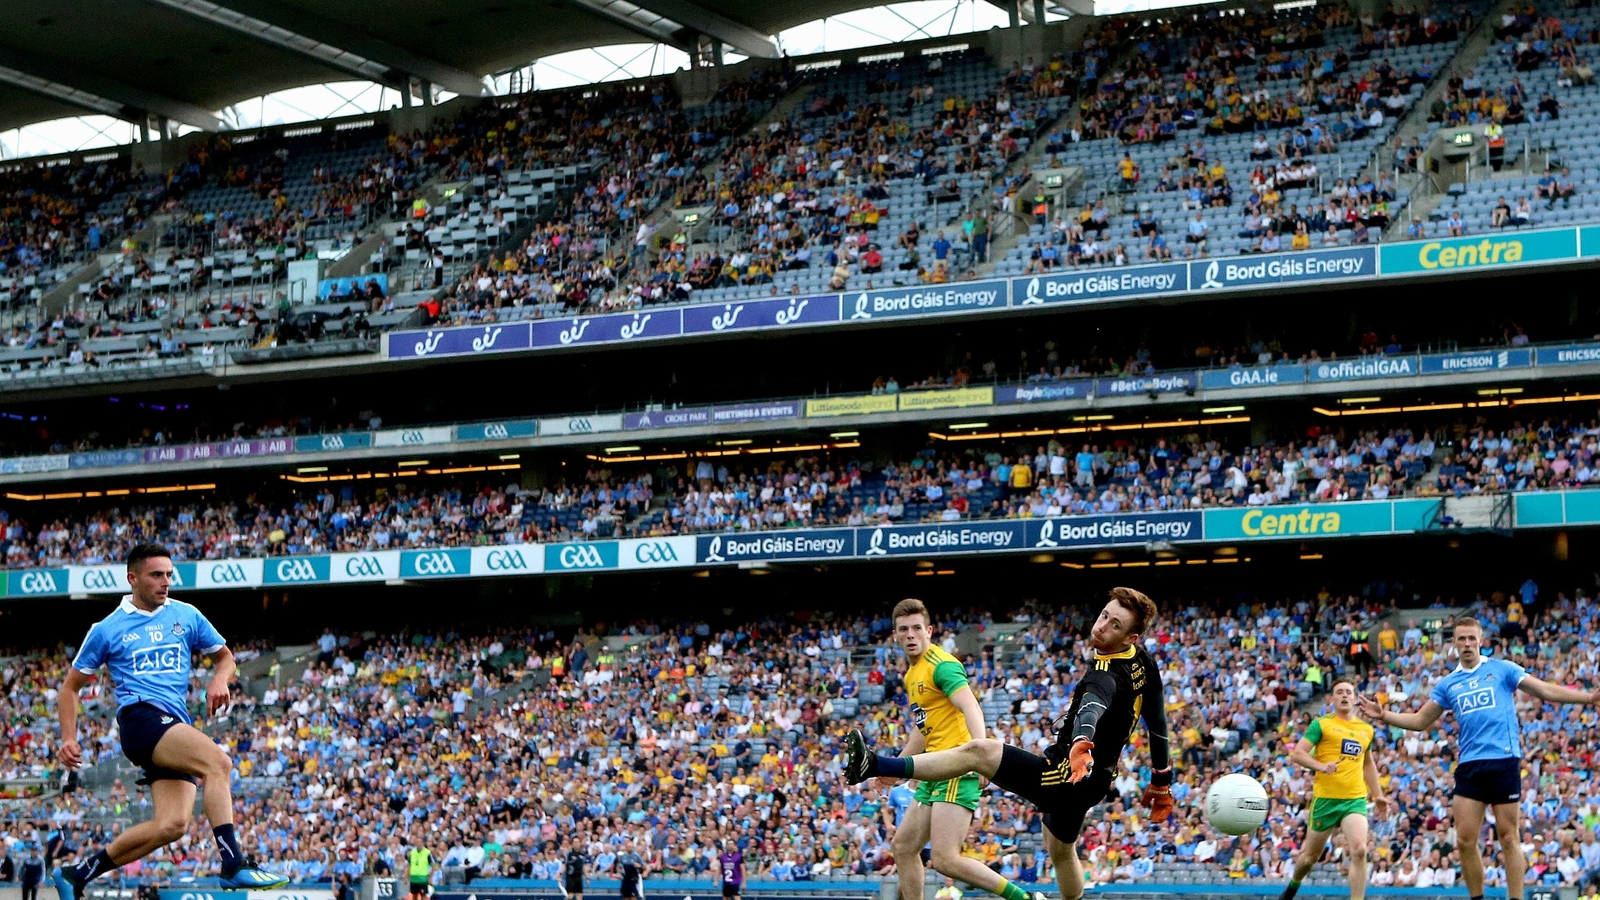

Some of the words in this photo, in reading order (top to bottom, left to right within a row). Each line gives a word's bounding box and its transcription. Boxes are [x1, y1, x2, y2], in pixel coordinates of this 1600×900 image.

[1419, 239, 1523, 269] Centra
[1226, 261, 1265, 281] Bord
[1268, 258, 1303, 277] Gáis
[1305, 257, 1364, 275] Energy
[1046, 277, 1082, 297] Bord
[1085, 274, 1120, 293] Gáis
[1121, 272, 1176, 290] Energy
[873, 295, 910, 312] Bord
[911, 292, 943, 310] Gáis
[945, 288, 997, 308] Energy
[711, 304, 744, 330] eir
[775, 298, 808, 325] eir
[559, 319, 590, 345] eir
[621, 313, 651, 339] eir
[414, 331, 443, 356] eir
[472, 326, 502, 351] eir
[1317, 358, 1410, 379] @officialGAA
[1442, 357, 1493, 370] ERICSSON
[1111, 377, 1183, 392] #BetOBoyle
[1230, 369, 1278, 386] GAA.ie
[664, 413, 687, 423] CROKE
[689, 412, 708, 422] PARK
[714, 409, 753, 420] MEETINGS
[761, 406, 793, 416] EVENTS
[484, 424, 508, 439] GAA
[568, 419, 592, 432] GAA
[269, 441, 286, 452] AIB
[321, 436, 344, 449] GAA
[401, 430, 424, 443] GAA
[159, 449, 176, 460] AIB
[193, 446, 210, 457] AIB
[233, 444, 250, 455] AIB
[1060, 522, 1098, 540] Bord
[1100, 520, 1134, 538] Gáis
[1136, 520, 1192, 538] Energy
[1241, 509, 1341, 536] Centra
[726, 539, 761, 556] Bord
[762, 537, 793, 554] Gáis
[795, 537, 845, 554] Energy
[888, 531, 925, 549] Bord
[926, 529, 959, 547] Gáis
[961, 530, 1013, 547] Energy
[486, 549, 528, 570] GAA
[560, 545, 604, 568] GAA
[635, 541, 678, 563] GAA
[211, 563, 247, 583] GAA
[277, 559, 317, 581] GAA
[346, 556, 385, 577] GAA
[414, 551, 456, 575] GAA
[20, 571, 57, 593] GAA
[83, 569, 117, 589] GAA
[149, 630, 163, 643] 10
[140, 650, 175, 670] AIG
[1462, 691, 1490, 709] AIG
[724, 869, 733, 882] 2
